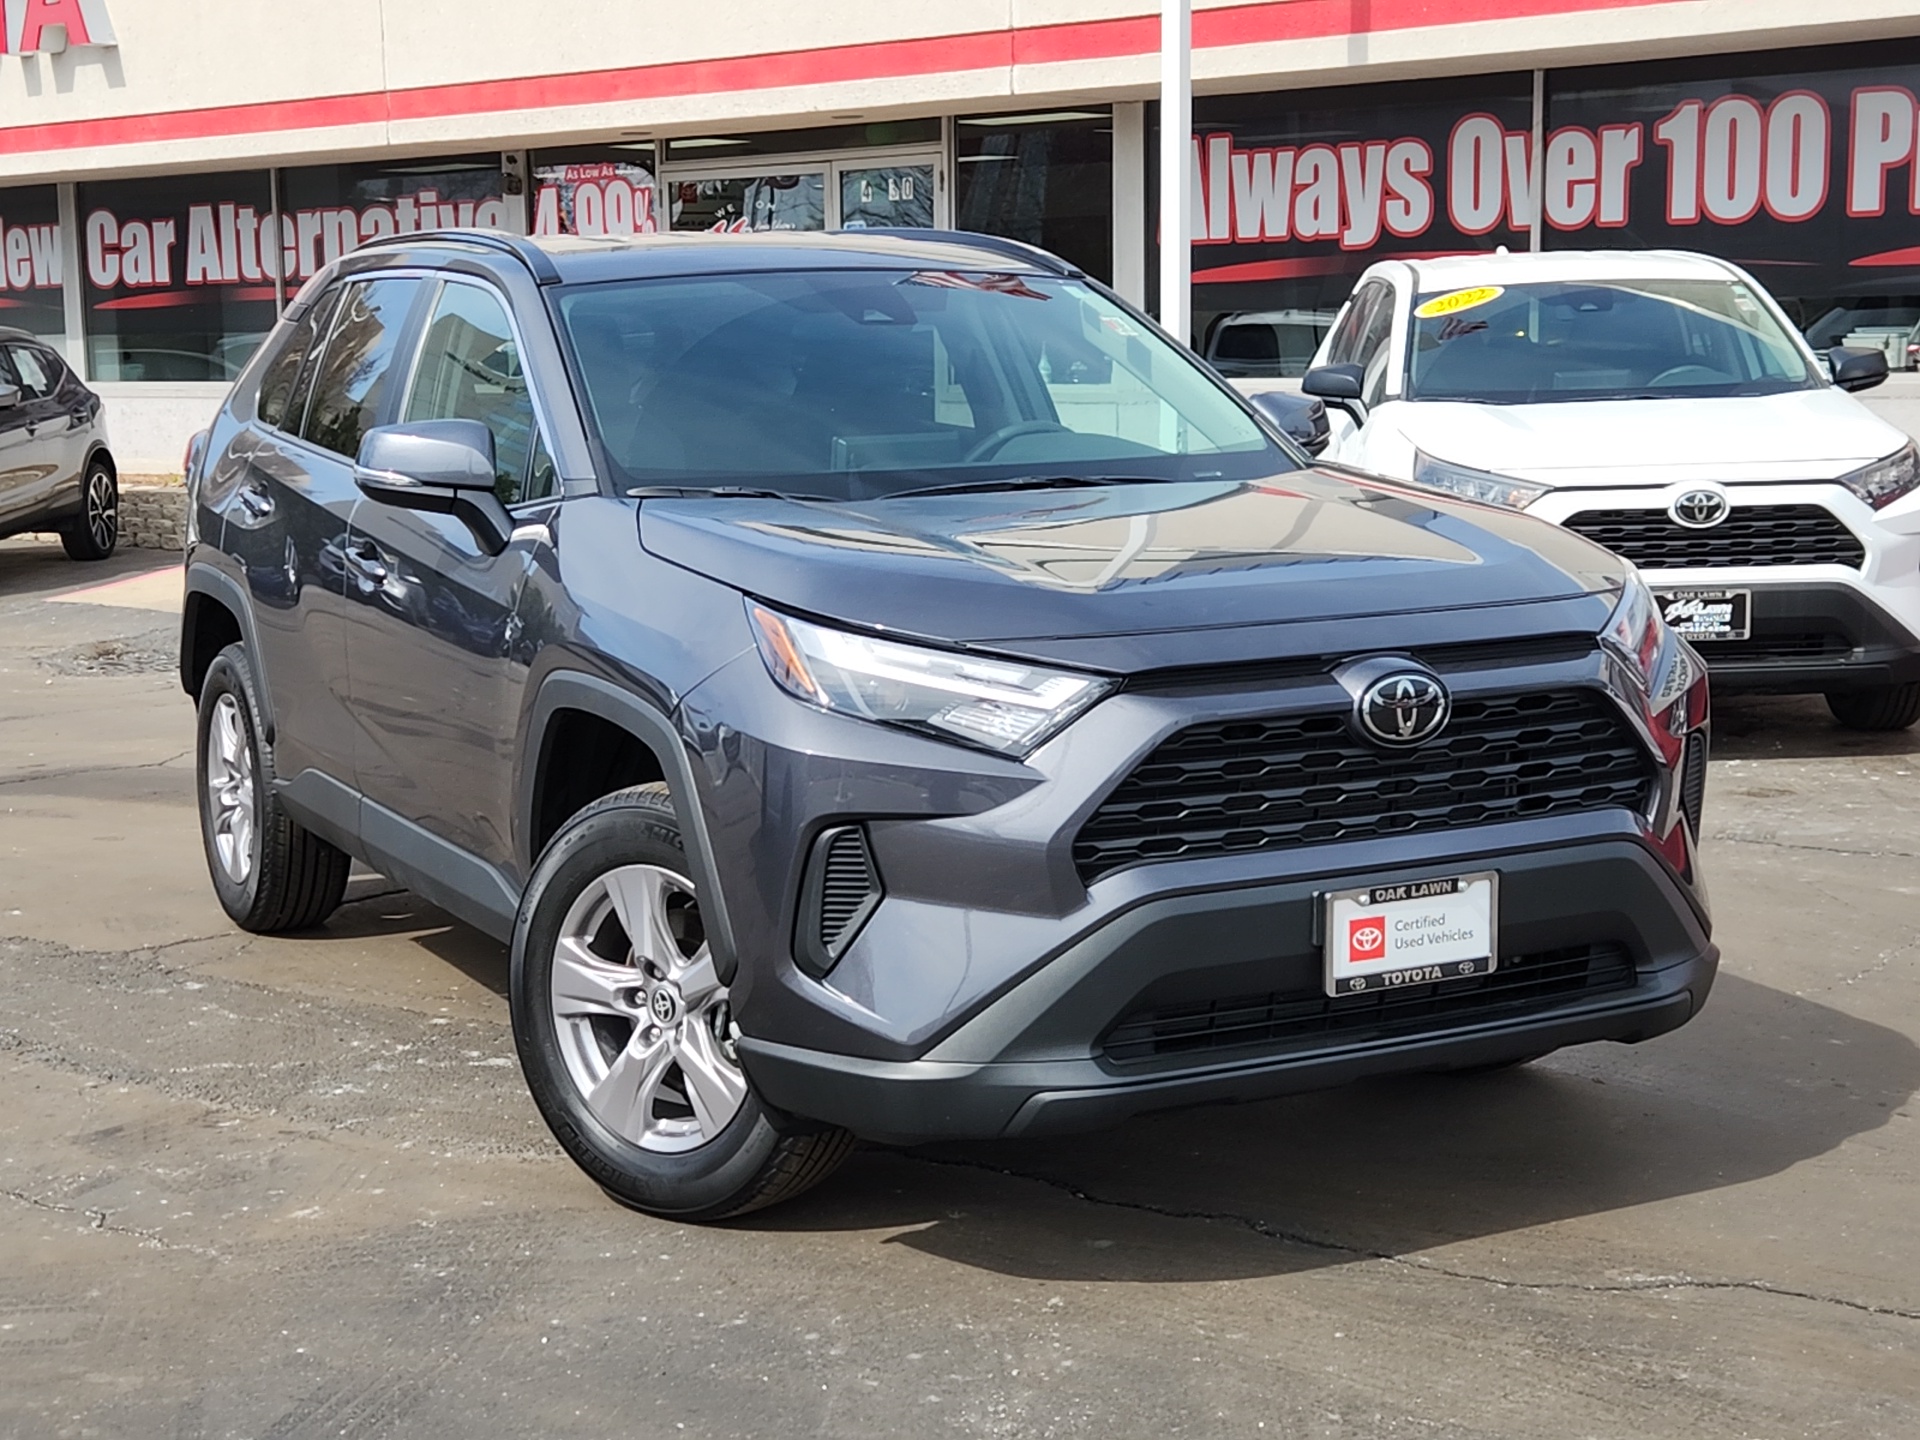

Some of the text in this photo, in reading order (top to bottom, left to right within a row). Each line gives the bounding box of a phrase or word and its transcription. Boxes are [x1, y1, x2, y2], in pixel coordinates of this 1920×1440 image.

[0, 0, 118, 57] A
[1447, 112, 1643, 235] Over
[1653, 90, 1831, 225] 100
[1846, 85, 1920, 218] P
[0, 216, 63, 291] ew
[86, 208, 176, 289] Car
[1435, 288, 1487, 313] 2022
[1375, 880, 1453, 902] OAK LAWN
[1394, 913, 1446, 932] Certified
[1394, 928, 1474, 950] Used Vehicles
[1382, 965, 1443, 987] TOYOTA
